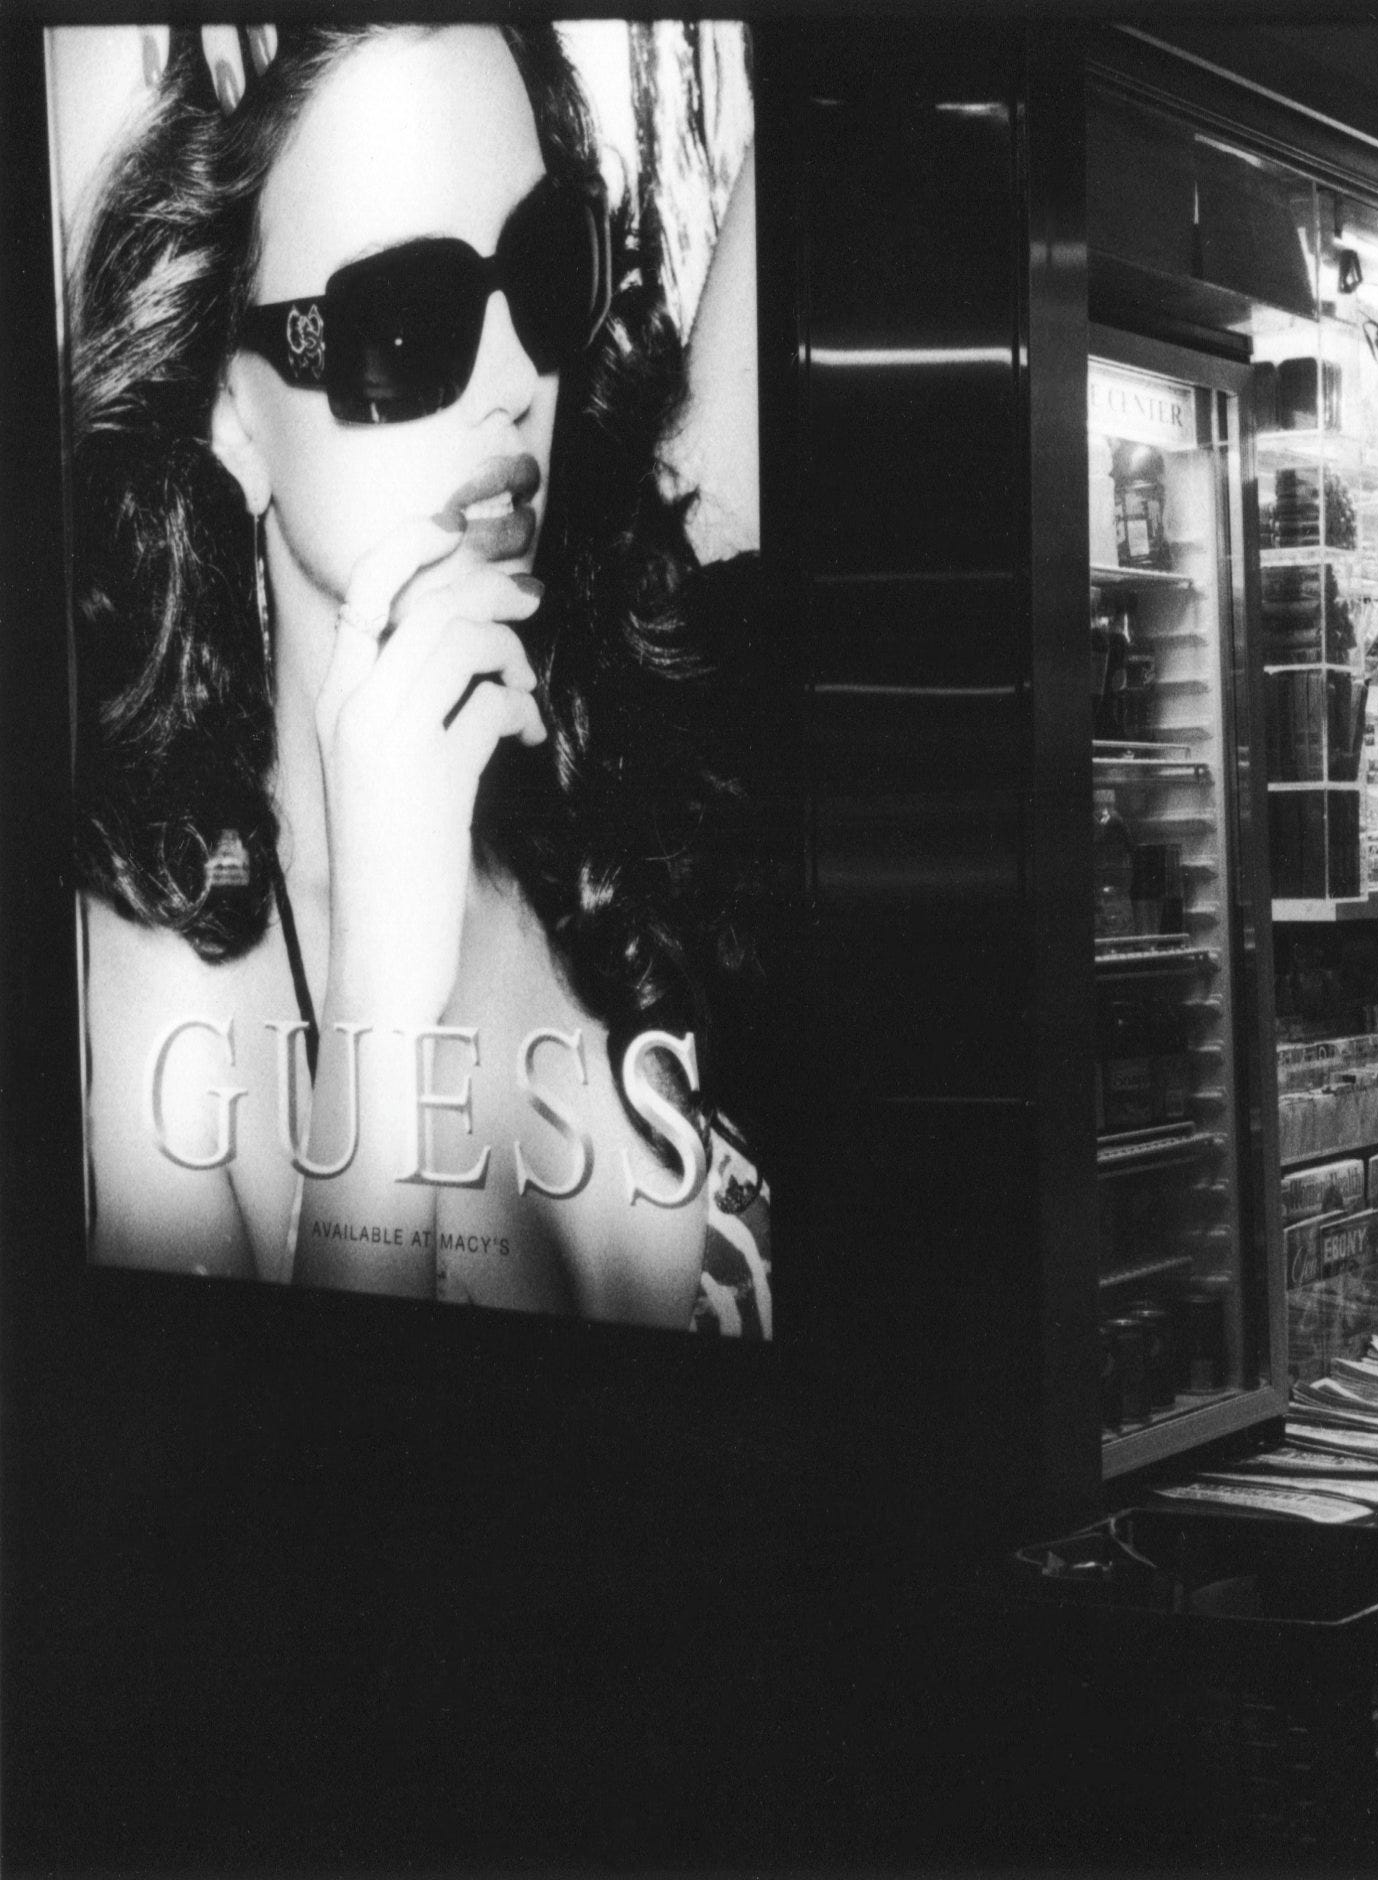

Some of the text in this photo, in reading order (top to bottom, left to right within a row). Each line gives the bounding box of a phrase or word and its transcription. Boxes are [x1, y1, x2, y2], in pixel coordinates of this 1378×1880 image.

[147, 1018, 707, 1209] GUESS
[312, 1220, 511, 1257] AVAILABLE AT MACY'S
[1324, 1226, 1368, 1263] EBONY
